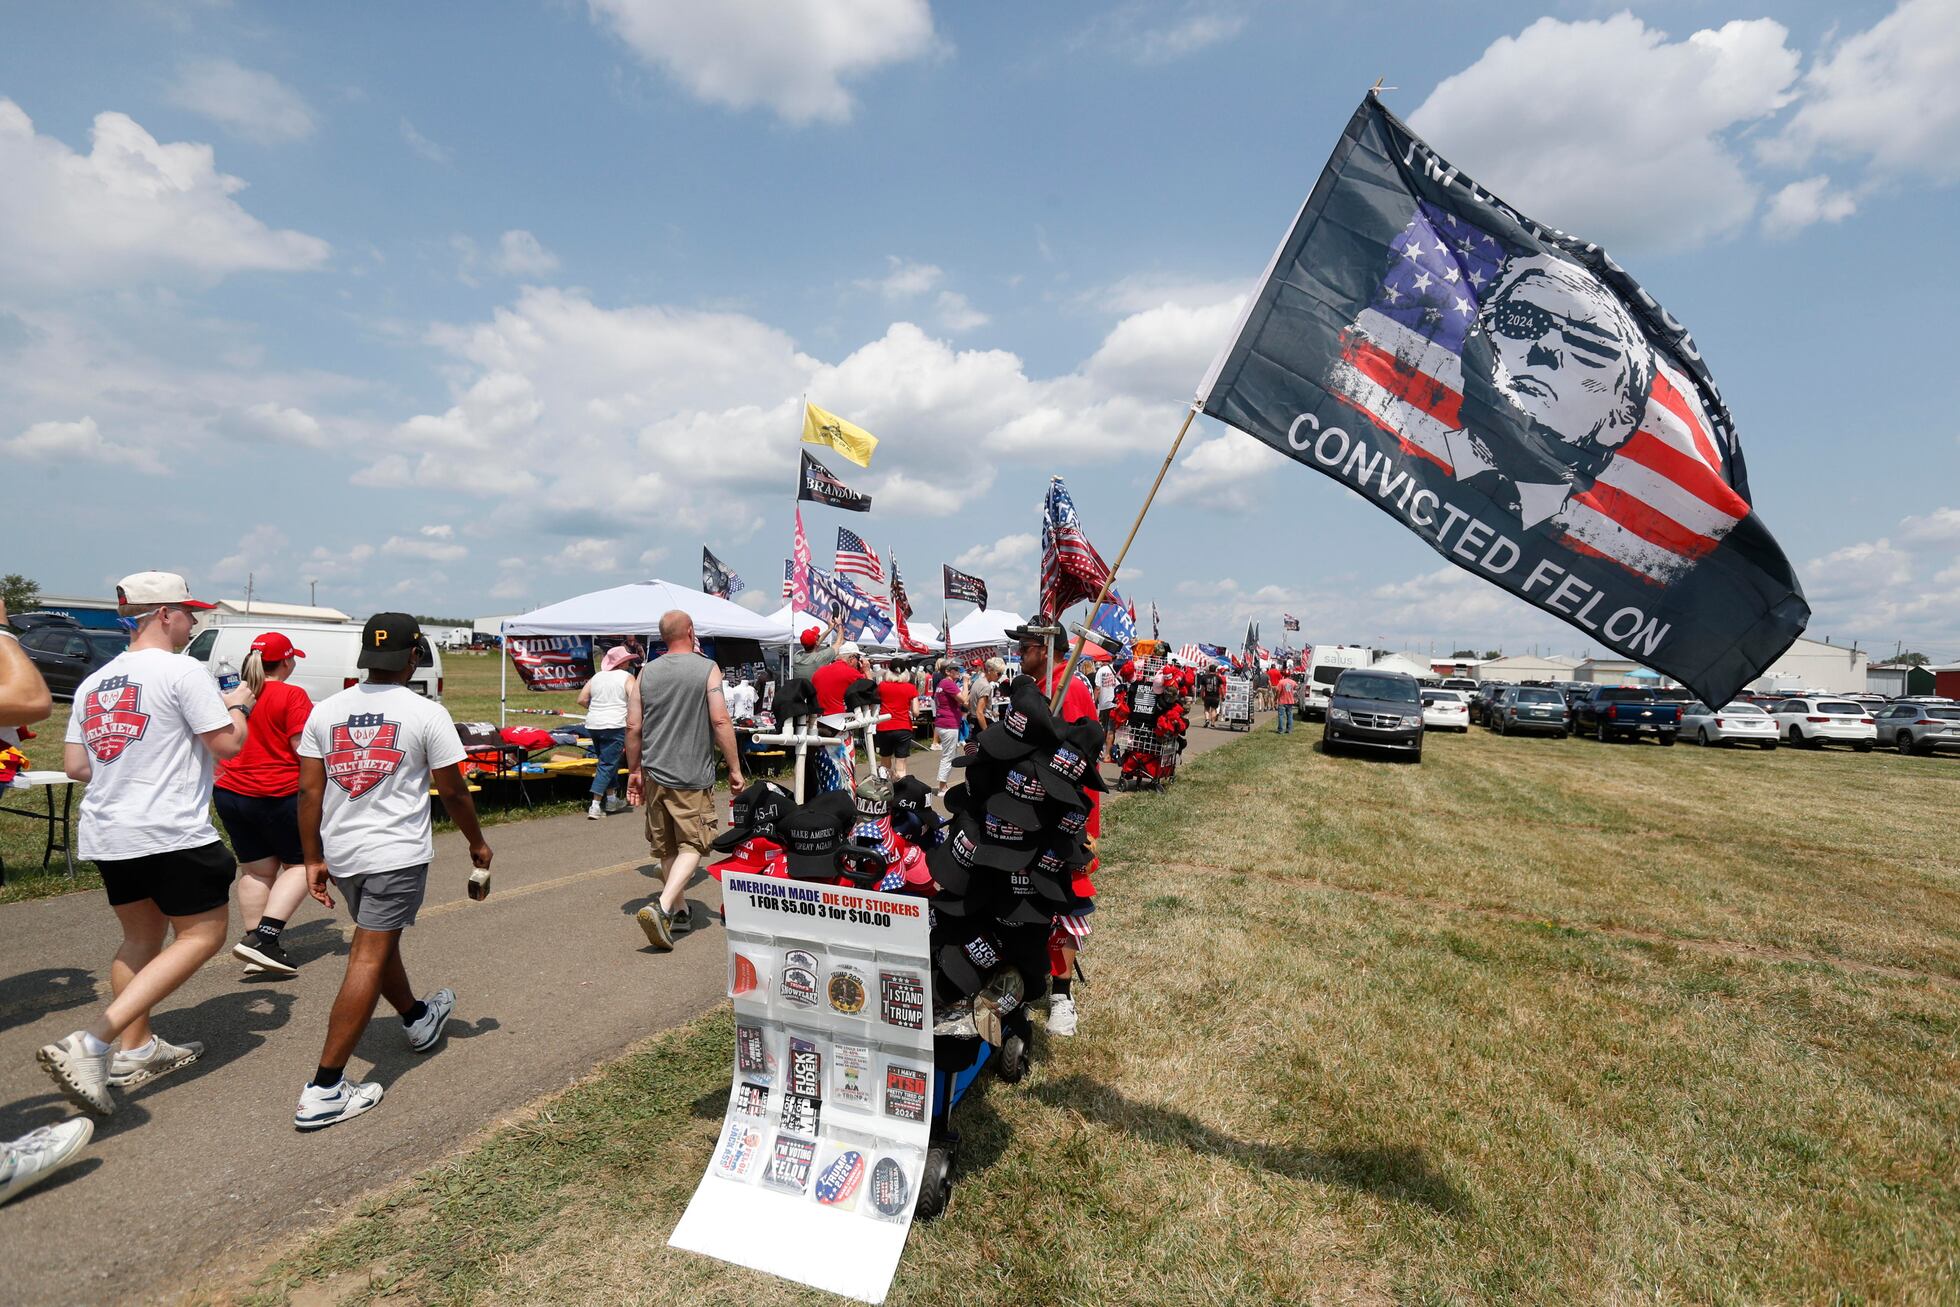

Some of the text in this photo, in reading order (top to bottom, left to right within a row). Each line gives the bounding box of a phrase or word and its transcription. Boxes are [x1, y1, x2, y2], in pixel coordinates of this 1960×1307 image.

[1507, 314, 1533, 328] 2024
[806, 477, 862, 500] BRANDON
[1288, 412, 1672, 656] CONVICTED FELON
[375, 630, 387, 646] P
[1324, 651, 1353, 666] salus
[755, 803, 779, 821] 45-47
[857, 797, 888, 815] MAGA
[730, 879, 786, 897] AMERICAN
[789, 887, 820, 903] MADE
[822, 893, 840, 906] DIE
[842, 895, 863, 909] CUT
[866, 897, 919, 918] STICKERS
[749, 895, 891, 928] 1 FOR $5.00 3 for $10.00
[968, 942, 992, 968] BIDEN
[975, 937, 1000, 964] FUCK
[781, 984, 818, 1003] SNOWFLAKE
[890, 989, 922, 1005] I STAND
[890, 1006, 922, 1023] TRUMP
[795, 1052, 806, 1094] FUCK
[805, 1053, 815, 1096] BIDEN
[900, 1070, 916, 1078] HAVE
[887, 1073, 925, 1094] PTSD
[887, 1088, 903, 1097] PRETTY
[895, 1109, 914, 1118] 2024
[727, 1124, 739, 1149] JACK
[776, 1144, 788, 1155] I'M
[788, 1146, 812, 1161] VOTING
[775, 1160, 807, 1180] FELON
[825, 1154, 847, 1187] TRUMP
[834, 1163, 853, 1188] 2024
